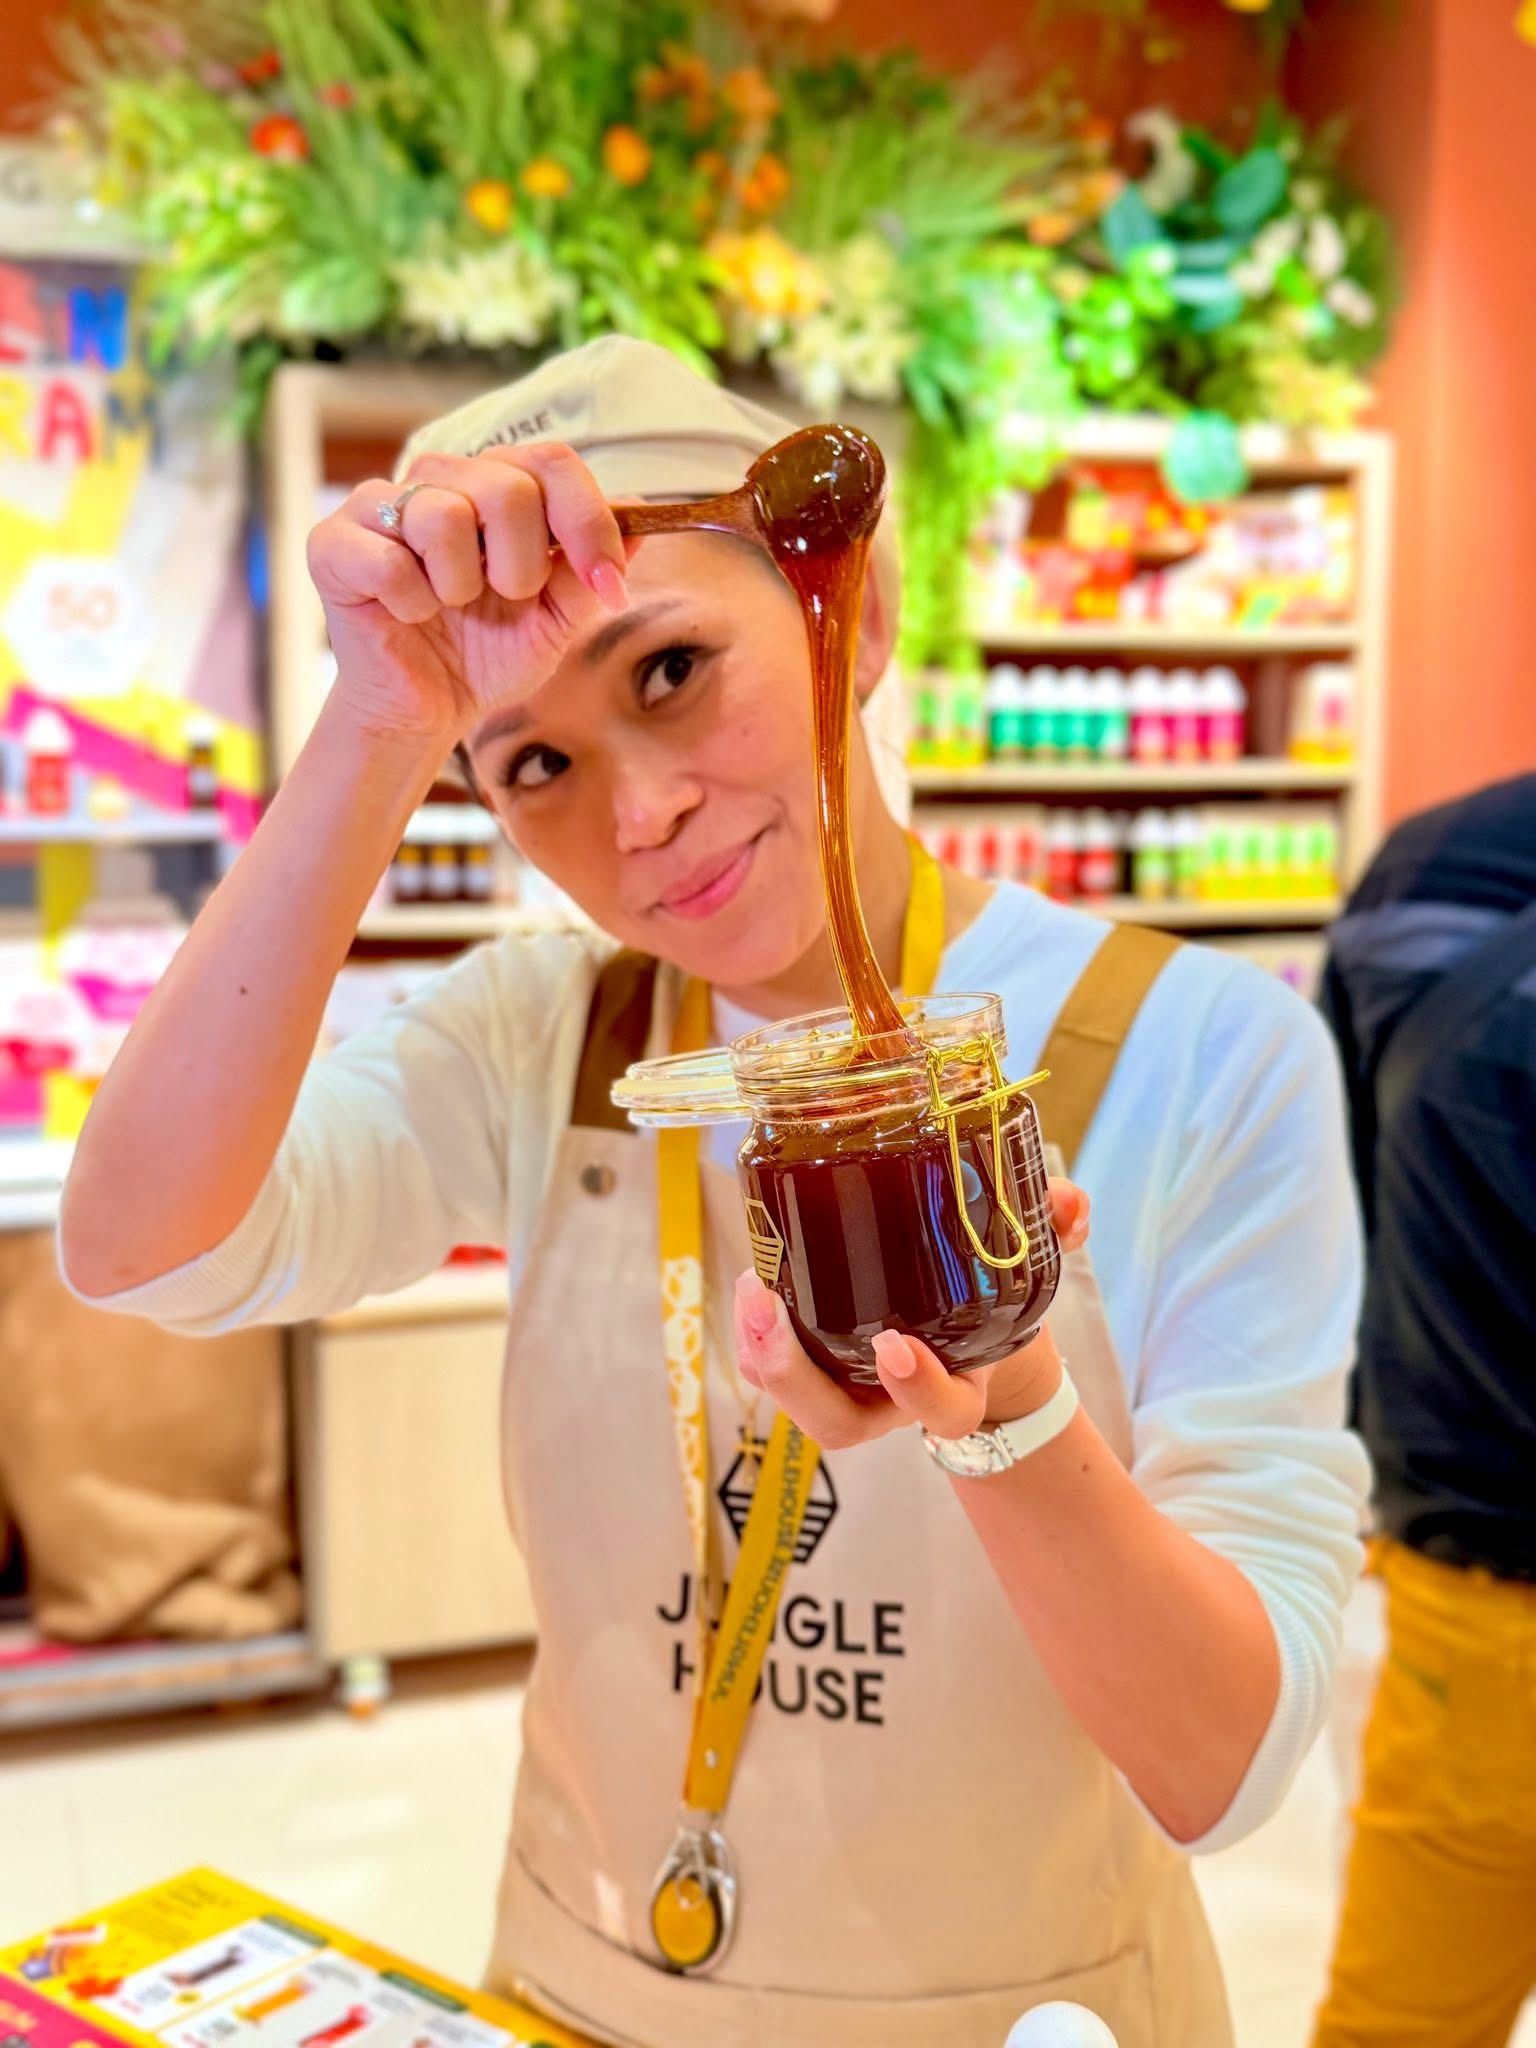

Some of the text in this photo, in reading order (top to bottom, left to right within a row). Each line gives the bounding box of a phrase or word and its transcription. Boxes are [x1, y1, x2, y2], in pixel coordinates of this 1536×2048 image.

[464, 408, 552, 460] OUSE
[656, 1573, 905, 1657] JGLE
[673, 1641, 884, 1726] HUSE
